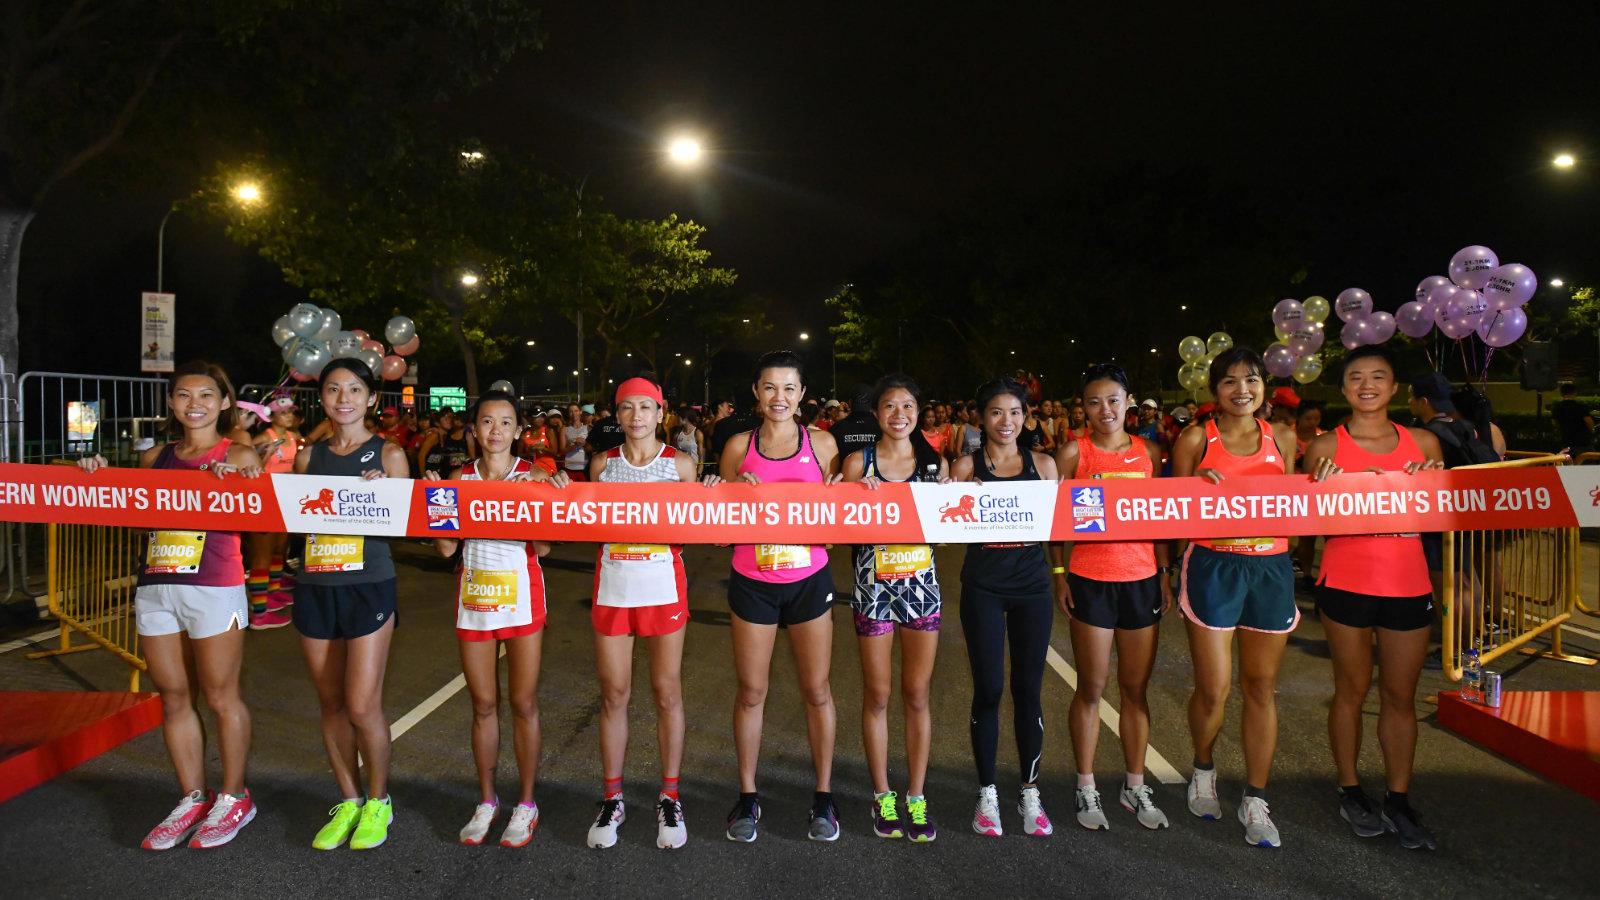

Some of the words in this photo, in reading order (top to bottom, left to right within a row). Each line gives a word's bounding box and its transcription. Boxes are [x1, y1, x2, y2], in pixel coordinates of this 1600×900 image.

[844, 434, 876, 442] SECURITY
[42, 485, 149, 510] WOMEN'S
[156, 489, 201, 512] RUN
[208, 492, 262, 514] 2019
[337, 488, 377, 504] Great
[978, 494, 1020, 508] Great
[338, 502, 390, 518] Eastern
[1116, 498, 1192, 521] GREAT
[1200, 495, 1308, 519] EASTERN
[1316, 491, 1430, 516] WOMEN'S
[1437, 489, 1487, 513] RUN
[1493, 487, 1551, 511] 2019
[470, 500, 544, 523] GREAT
[552, 501, 659, 525] EASTERN
[666, 502, 780, 526] WOMEN'S
[788, 502, 836, 526] RUN
[843, 502, 901, 526] 2019
[979, 508, 1034, 523] Eastern
[151, 544, 195, 558] E20006
[311, 543, 357, 557] E20005
[881, 549, 926, 565] E20002
[467, 583, 510, 597] E20011
